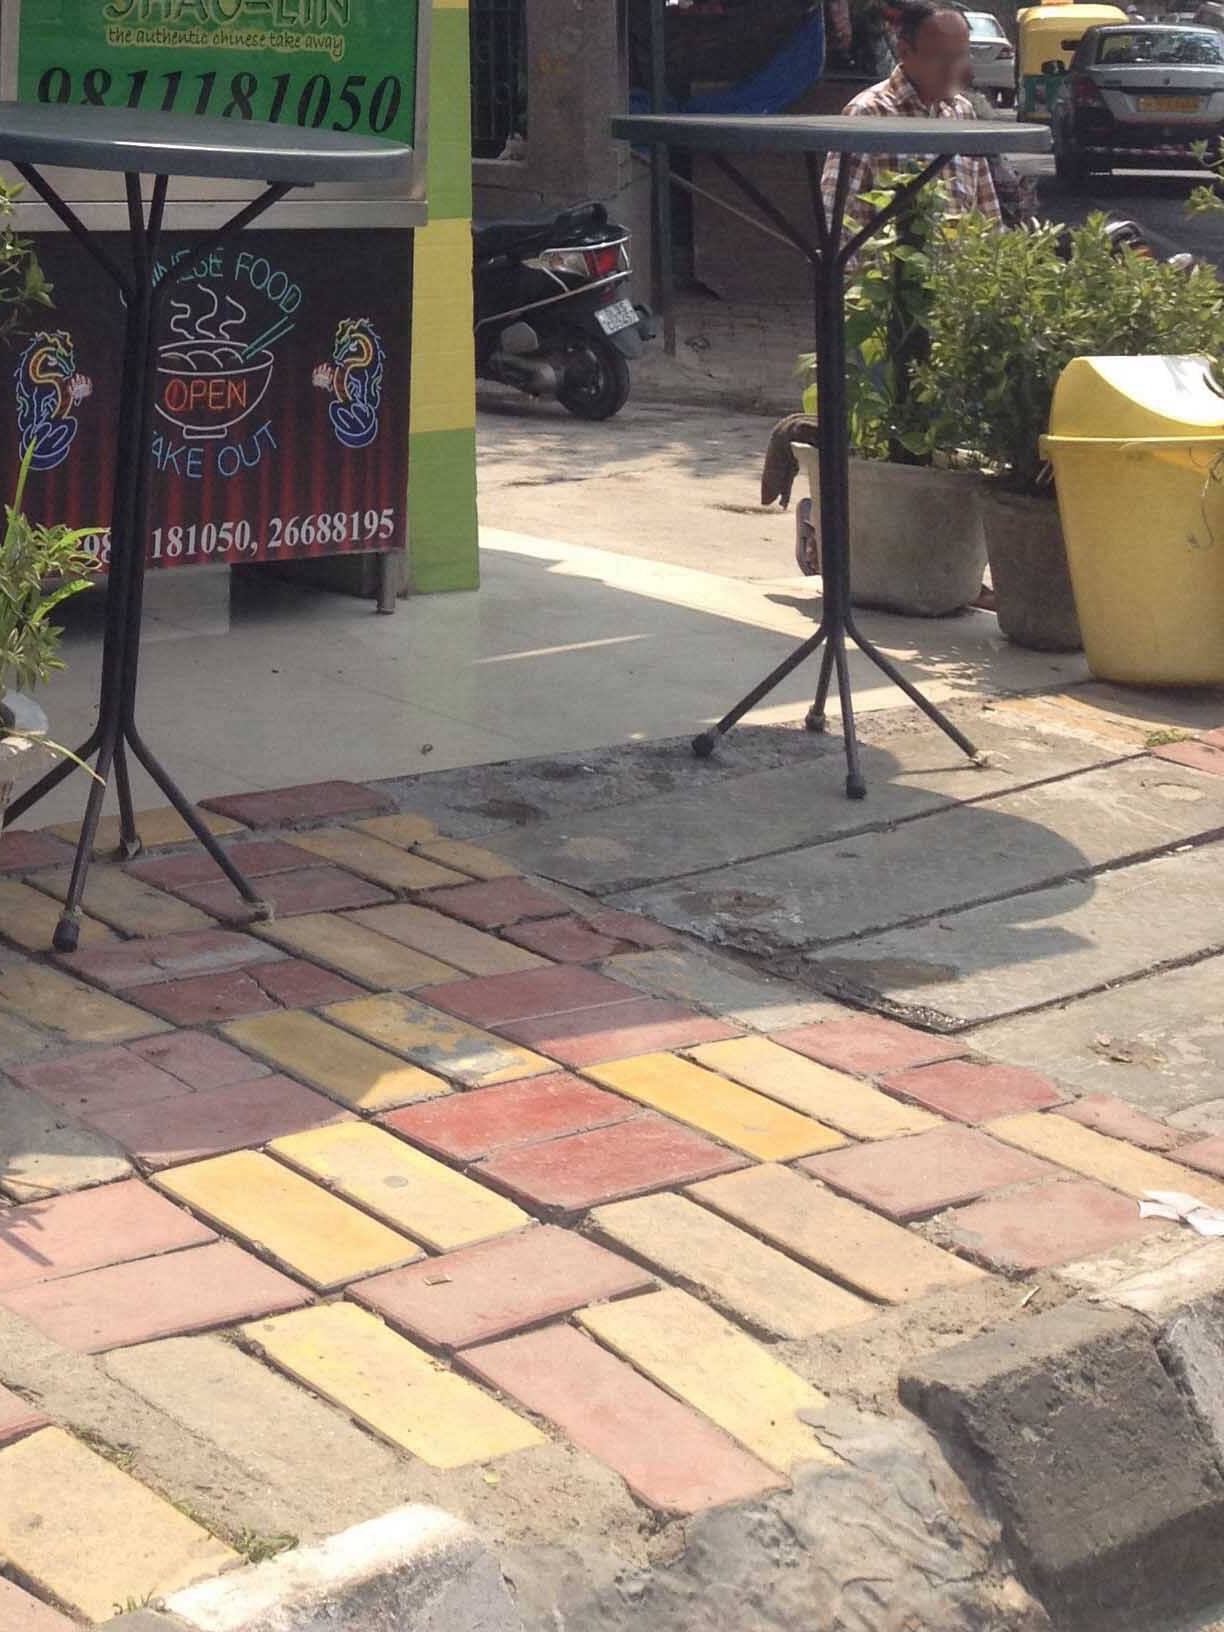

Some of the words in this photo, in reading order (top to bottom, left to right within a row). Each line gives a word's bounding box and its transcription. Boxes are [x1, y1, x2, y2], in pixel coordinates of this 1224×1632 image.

[109, 27, 131, 44] the
[136, 28, 208, 46] authentic
[212, 30, 266, 47] chinese
[269, 31, 301, 49] take
[305, 36, 343, 57] away
[234, 252, 303, 313] FOOD
[164, 377, 247, 412] OPEN
[151, 431, 205, 478] AKE
[217, 419, 277, 477] OUT
[266, 507, 395, 548] 26688195
